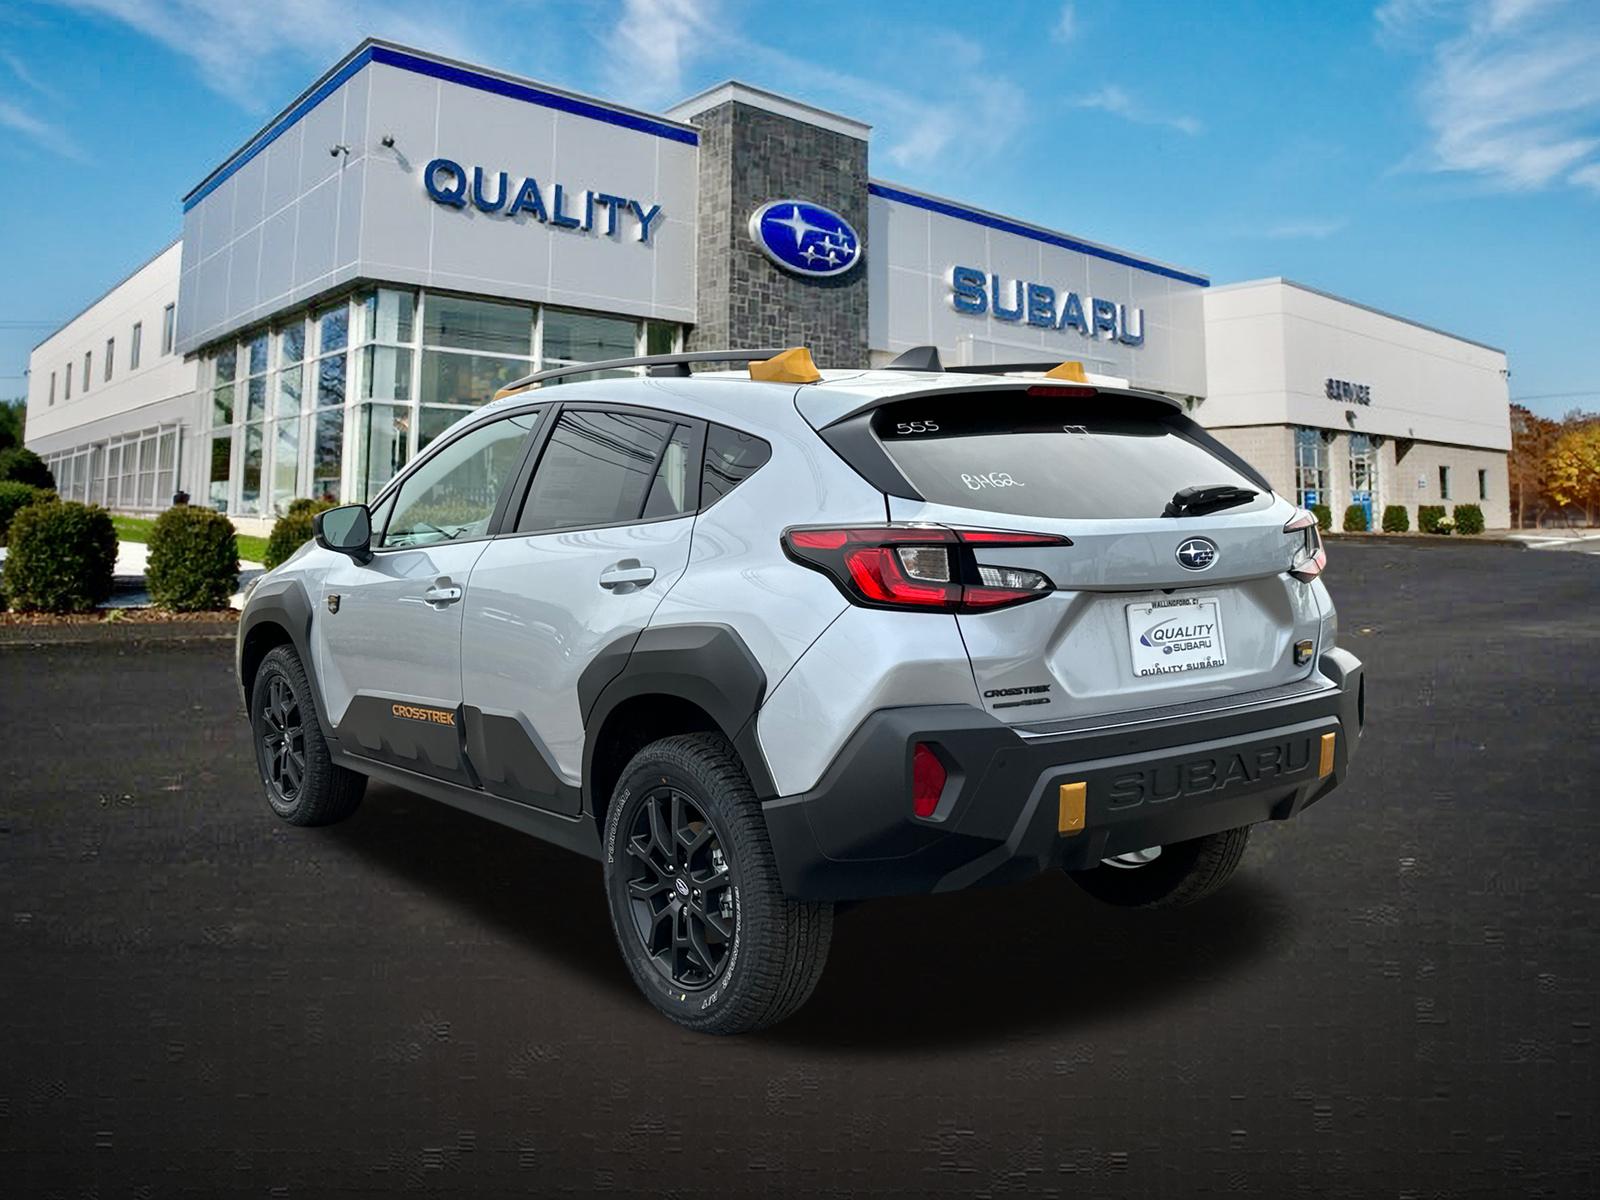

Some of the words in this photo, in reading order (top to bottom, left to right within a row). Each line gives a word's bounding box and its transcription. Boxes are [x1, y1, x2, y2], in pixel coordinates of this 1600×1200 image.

[424, 158, 661, 242] QUALITY
[952, 265, 1145, 346] SUBARU
[896, 420, 939, 434] 555
[1153, 624, 1214, 641] QUALITY
[1173, 640, 1212, 652] SUBARU
[1140, 664, 1183, 677] QUALITY
[1186, 659, 1225, 671] SUBARU
[983, 684, 1051, 698] CROSSTREK
[392, 704, 455, 726] CROSSTREK
[1108, 738, 1311, 811] SUBARU
